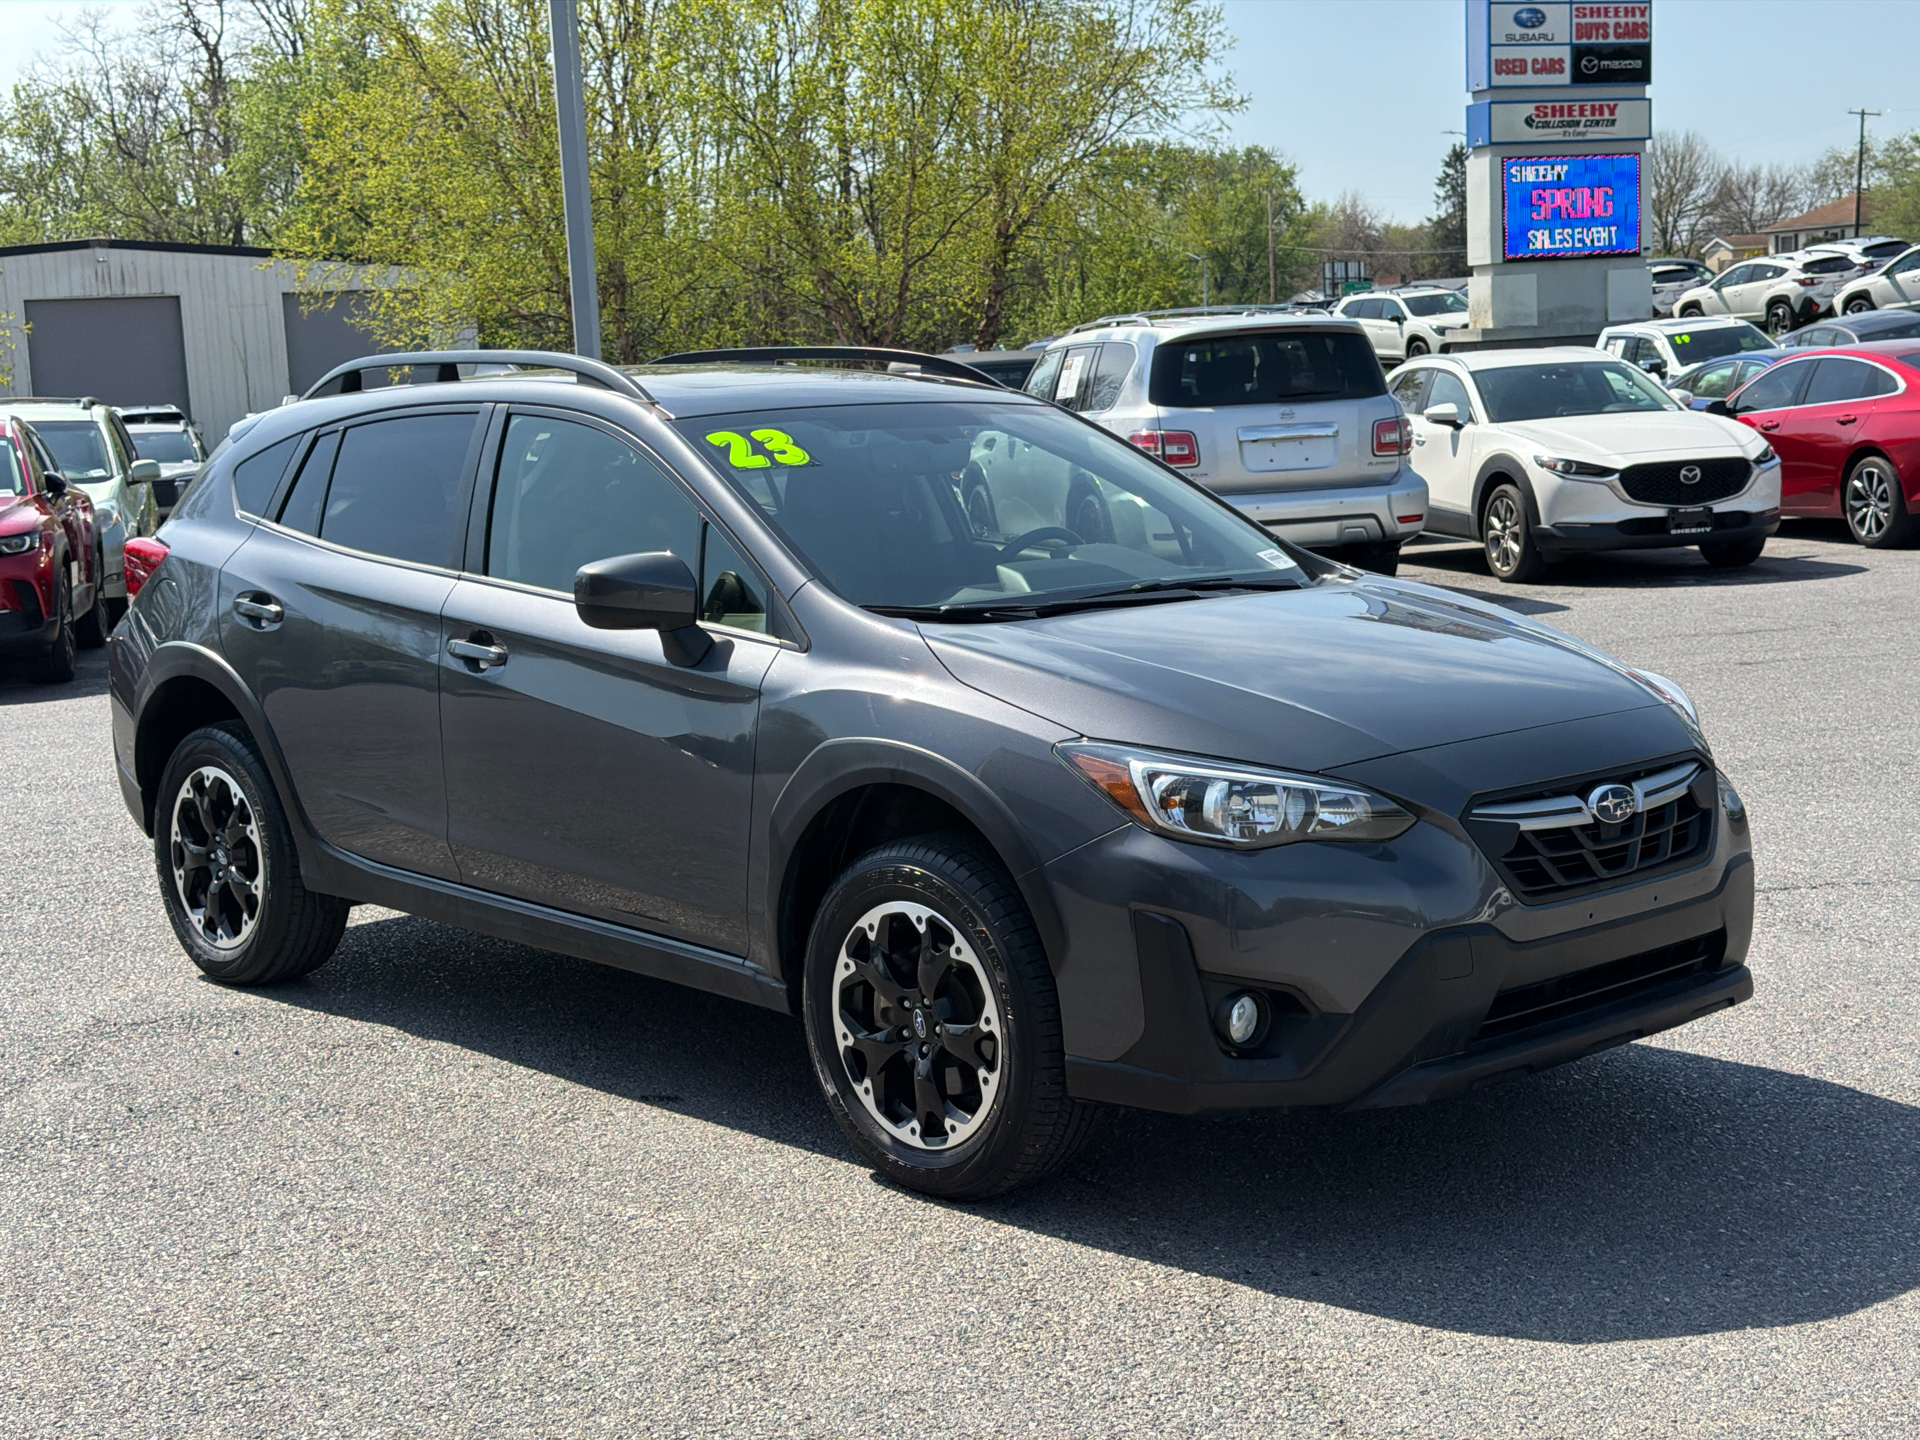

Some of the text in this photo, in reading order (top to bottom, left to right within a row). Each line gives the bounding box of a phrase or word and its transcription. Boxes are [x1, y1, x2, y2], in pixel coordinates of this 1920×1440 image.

[1574, 6, 1649, 19] SHEEHY
[1505, 33, 1554, 42] SUBARU
[1575, 21, 1649, 40] BUYS CARS
[1494, 57, 1565, 76] USED CARS
[1600, 59, 1642, 70] mazda
[1533, 103, 1619, 119] SHEEHY
[1535, 118, 1617, 130] COLLISION CENTER
[1510, 164, 1568, 182] SHEEHY
[1531, 187, 1613, 220] SPRING
[1528, 226, 1617, 249] SALES EVENT
[705, 429, 810, 469] 23
